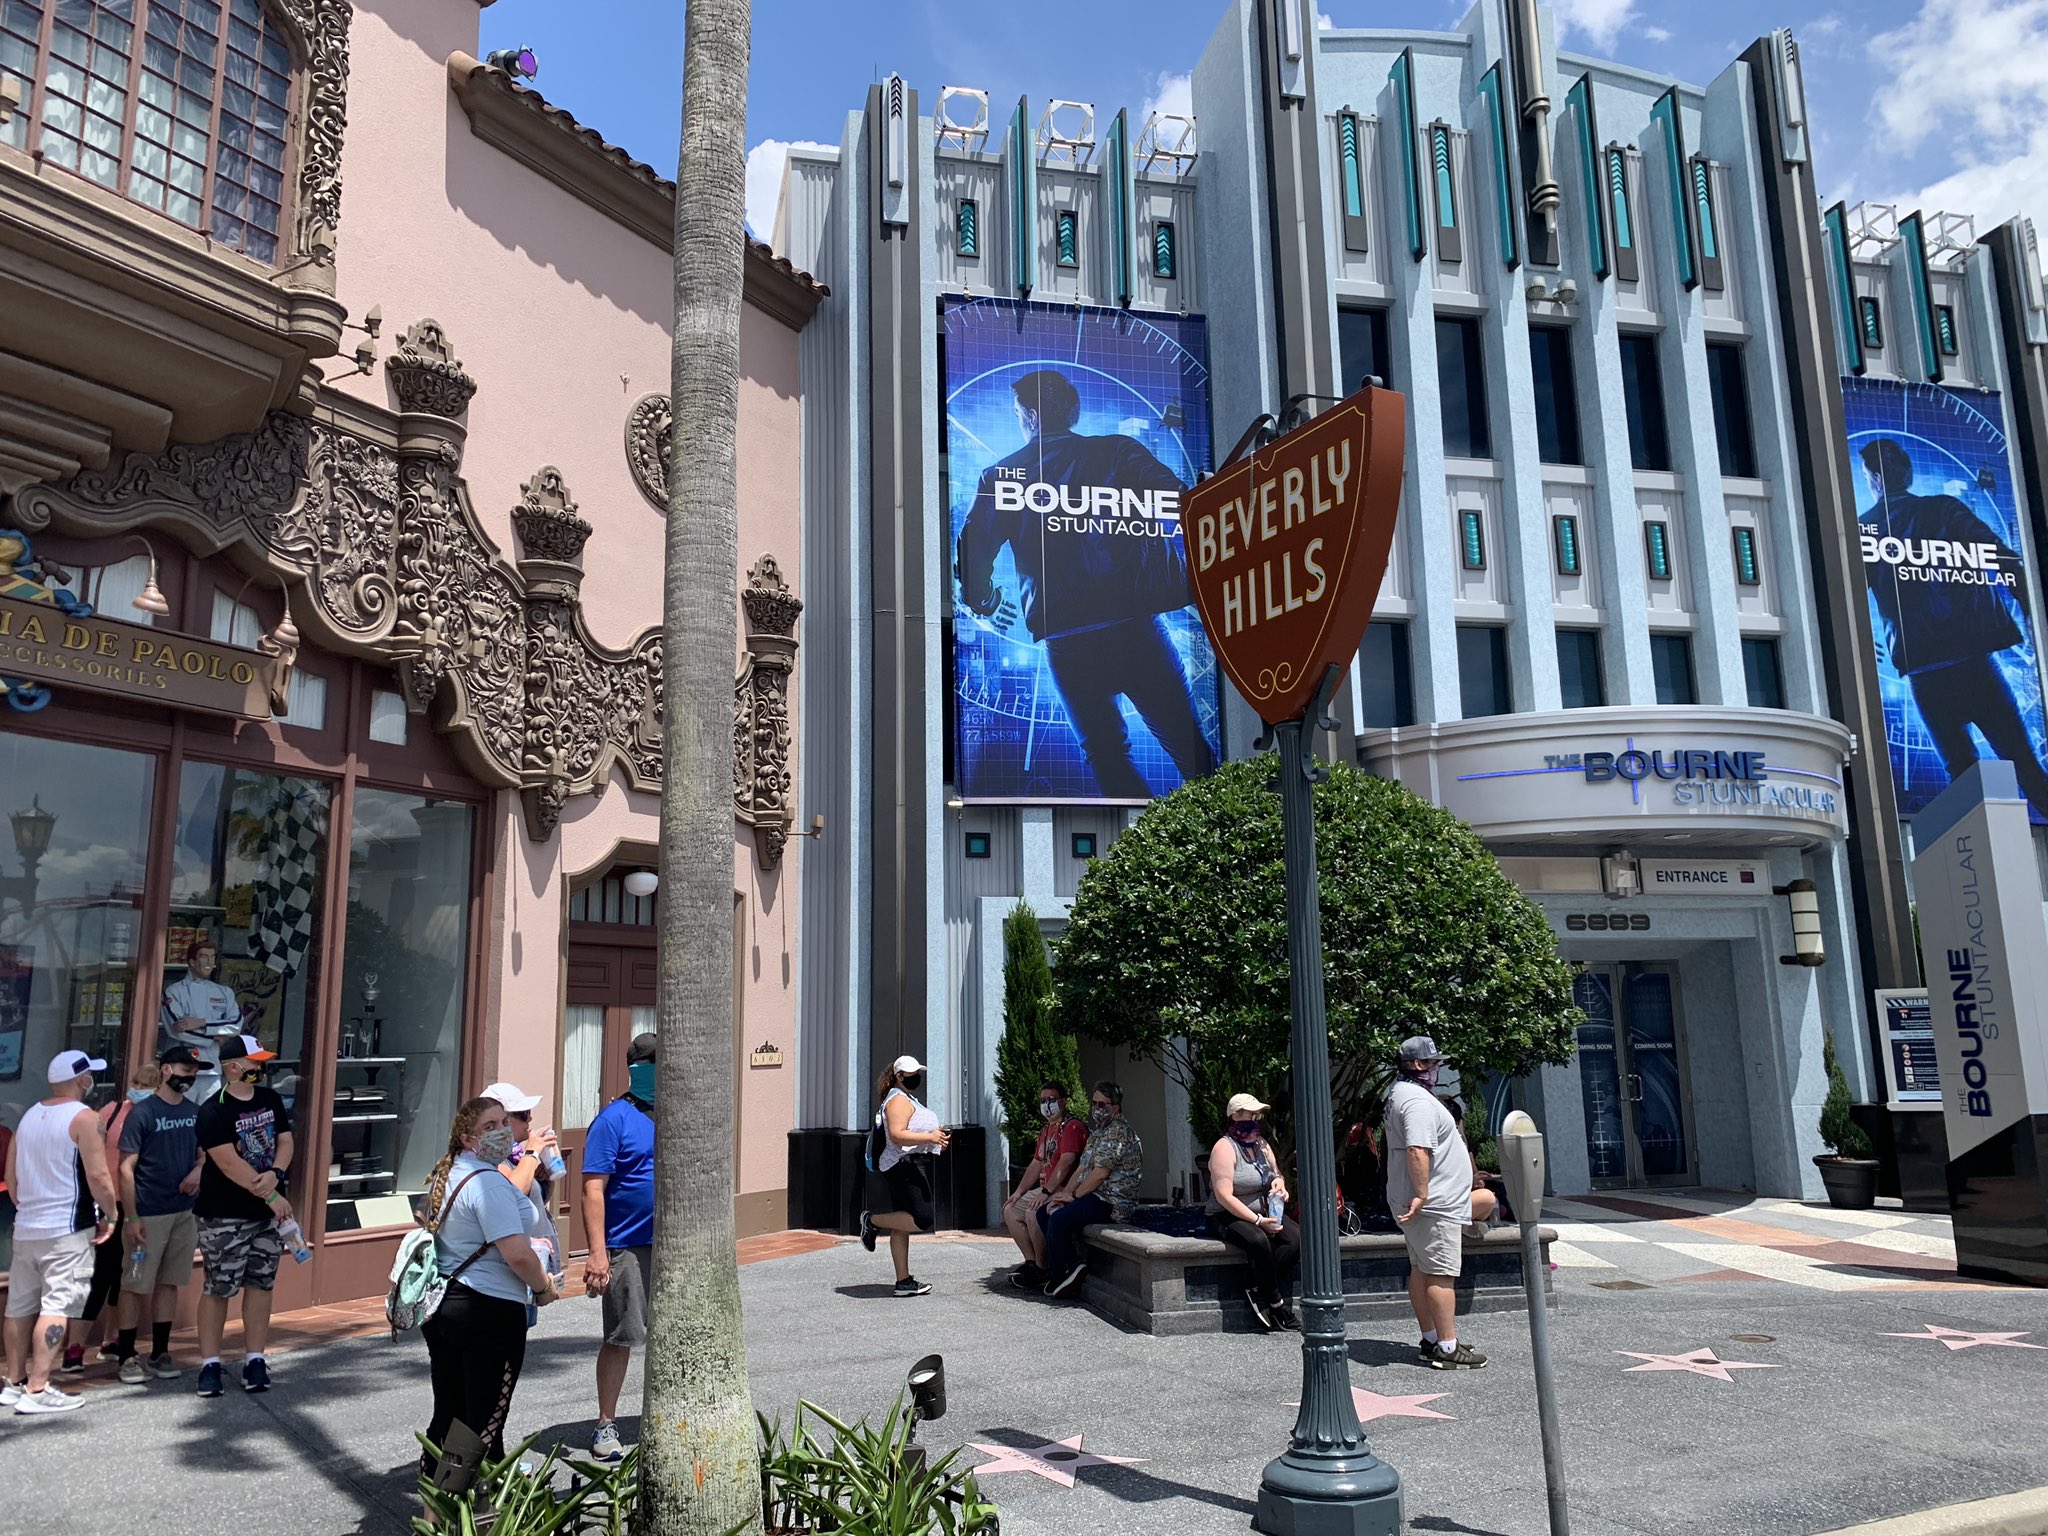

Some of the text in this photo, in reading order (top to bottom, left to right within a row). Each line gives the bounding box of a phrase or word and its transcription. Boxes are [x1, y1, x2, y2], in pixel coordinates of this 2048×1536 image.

[995, 466, 1026, 480] THE
[994, 480, 1180, 520] BOURNE
[1198, 438, 1350, 573] BEVERLY
[1047, 516, 1183, 538] STUNTACULA
[1860, 536, 2000, 570] BOURNE
[1223, 537, 1326, 637] HILLS
[1898, 566, 2017, 587] STUNTACULAR
[61, 622, 120, 657] DE
[132, 638, 255, 684] PAOLO
[1544, 750, 1768, 782] THE BOURNE
[1675, 781, 1836, 813] STUNTACULAR
[1656, 870, 1728, 883] ENTRANCE
[1957, 834, 1999, 1041] STUNTACULAR
[1905, 998, 1930, 1006] WARN
[1947, 948, 1992, 1117] BOURNE
[1960, 1088, 1968, 1115] THE
[154, 1114, 197, 1132] Hawai
